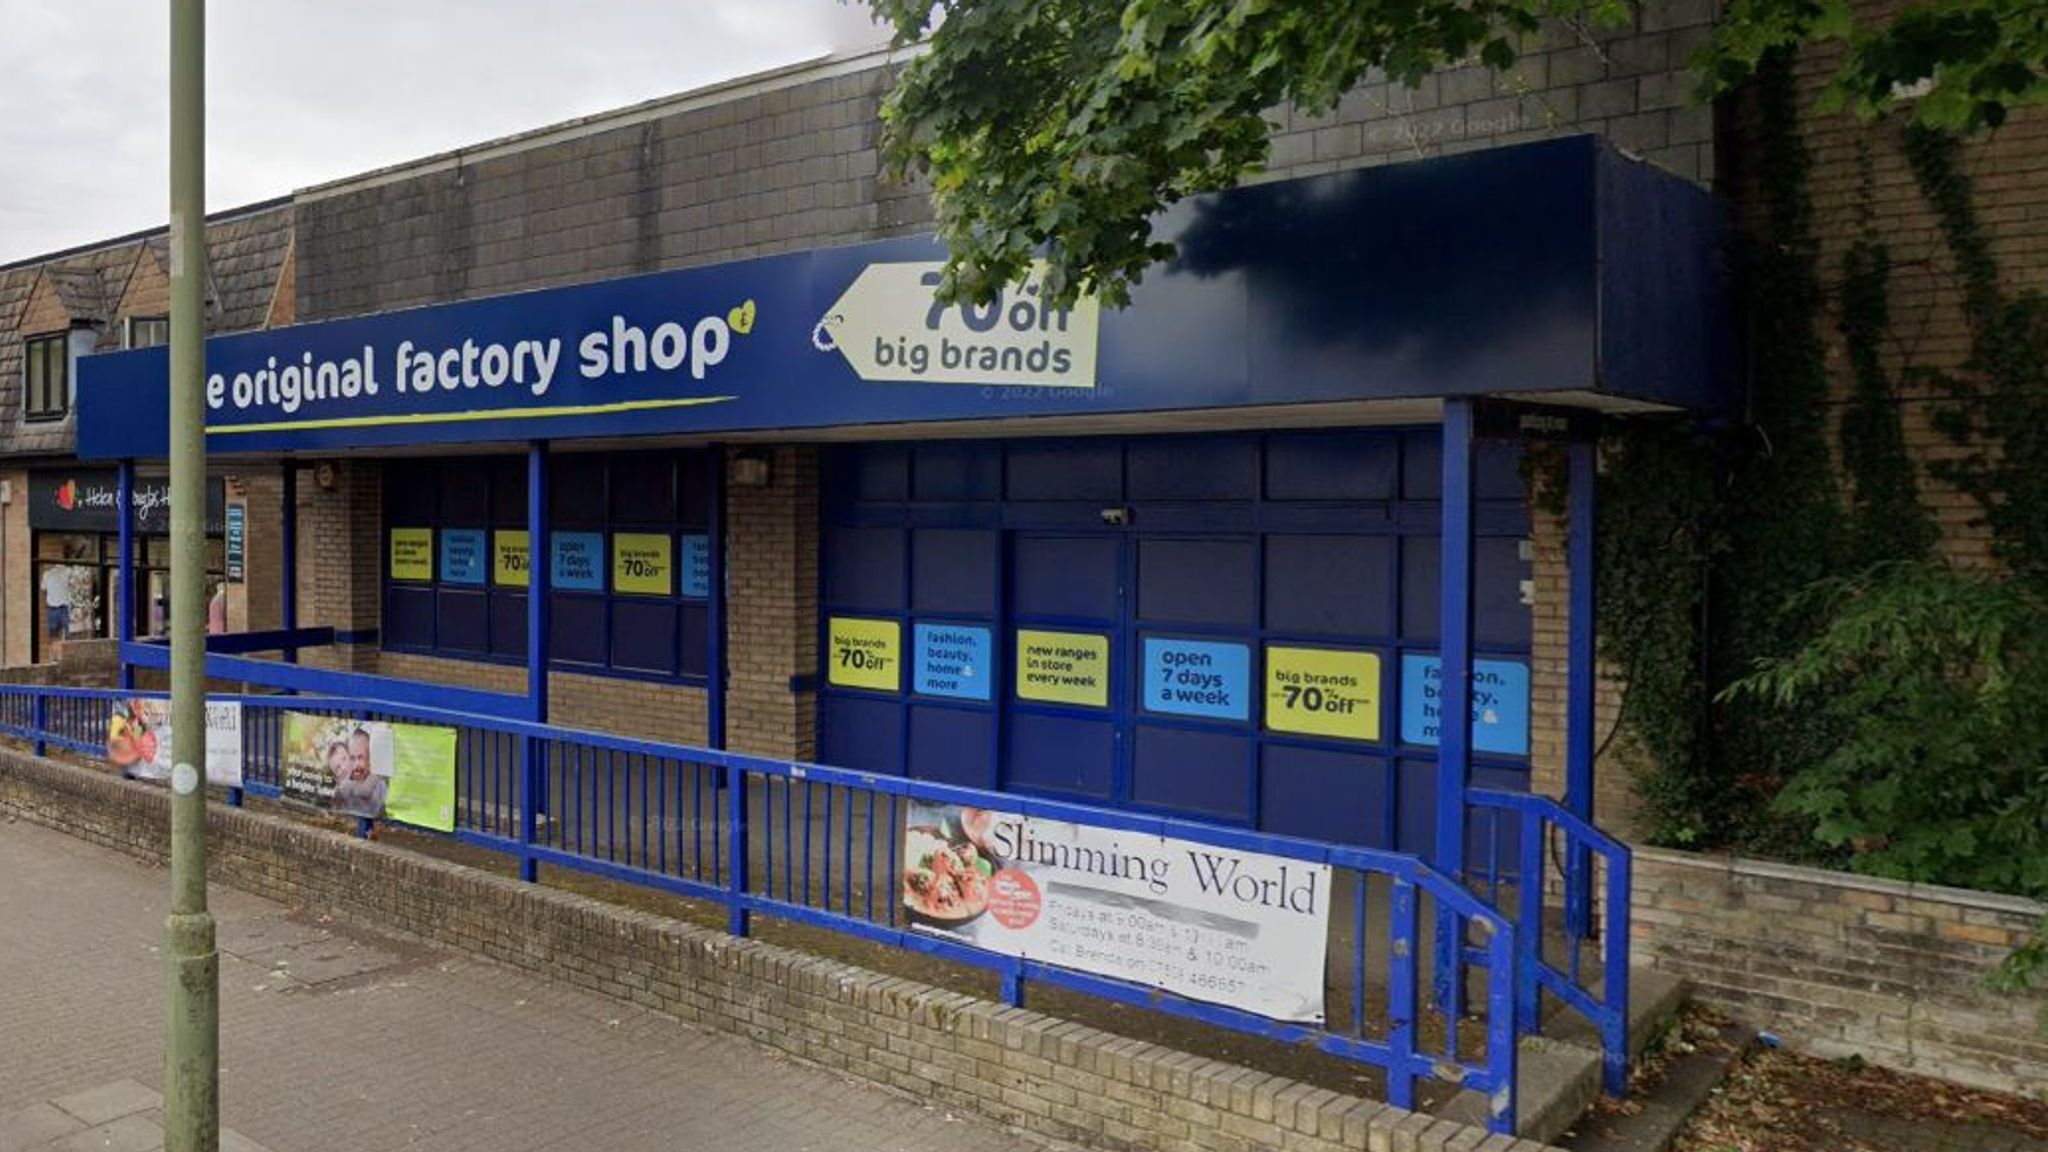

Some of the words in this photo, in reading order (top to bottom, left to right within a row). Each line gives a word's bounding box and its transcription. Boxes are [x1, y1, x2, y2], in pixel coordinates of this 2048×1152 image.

[232, 345, 378, 413] original
[396, 337, 561, 396] factory
[578, 314, 731, 380] shop
[874, 336, 929, 374] big
[940, 338, 1072, 374] brands
[834, 635, 851, 647] big
[852, 637, 886, 649] brands
[1027, 646, 1053, 656] new
[1055, 648, 1097, 660] ranges
[1162, 651, 1212, 668] open
[866, 657, 884, 670] off
[927, 660, 961, 675] home
[1027, 657, 1040, 668] in
[1041, 659, 1073, 671] store
[927, 678, 958, 690] more
[1027, 673, 1060, 686] every
[1062, 675, 1097, 687] week
[1162, 669, 1174, 683] 7
[1177, 669, 1224, 690] days
[1275, 669, 1301, 684] big
[1303, 672, 1359, 687] brands
[1161, 688, 1172, 701] a
[1176, 689, 1230, 706] week
[1325, 697, 1356, 714] off
[991, 818, 1171, 894] Slimming
[1186, 850, 1317, 916] World
